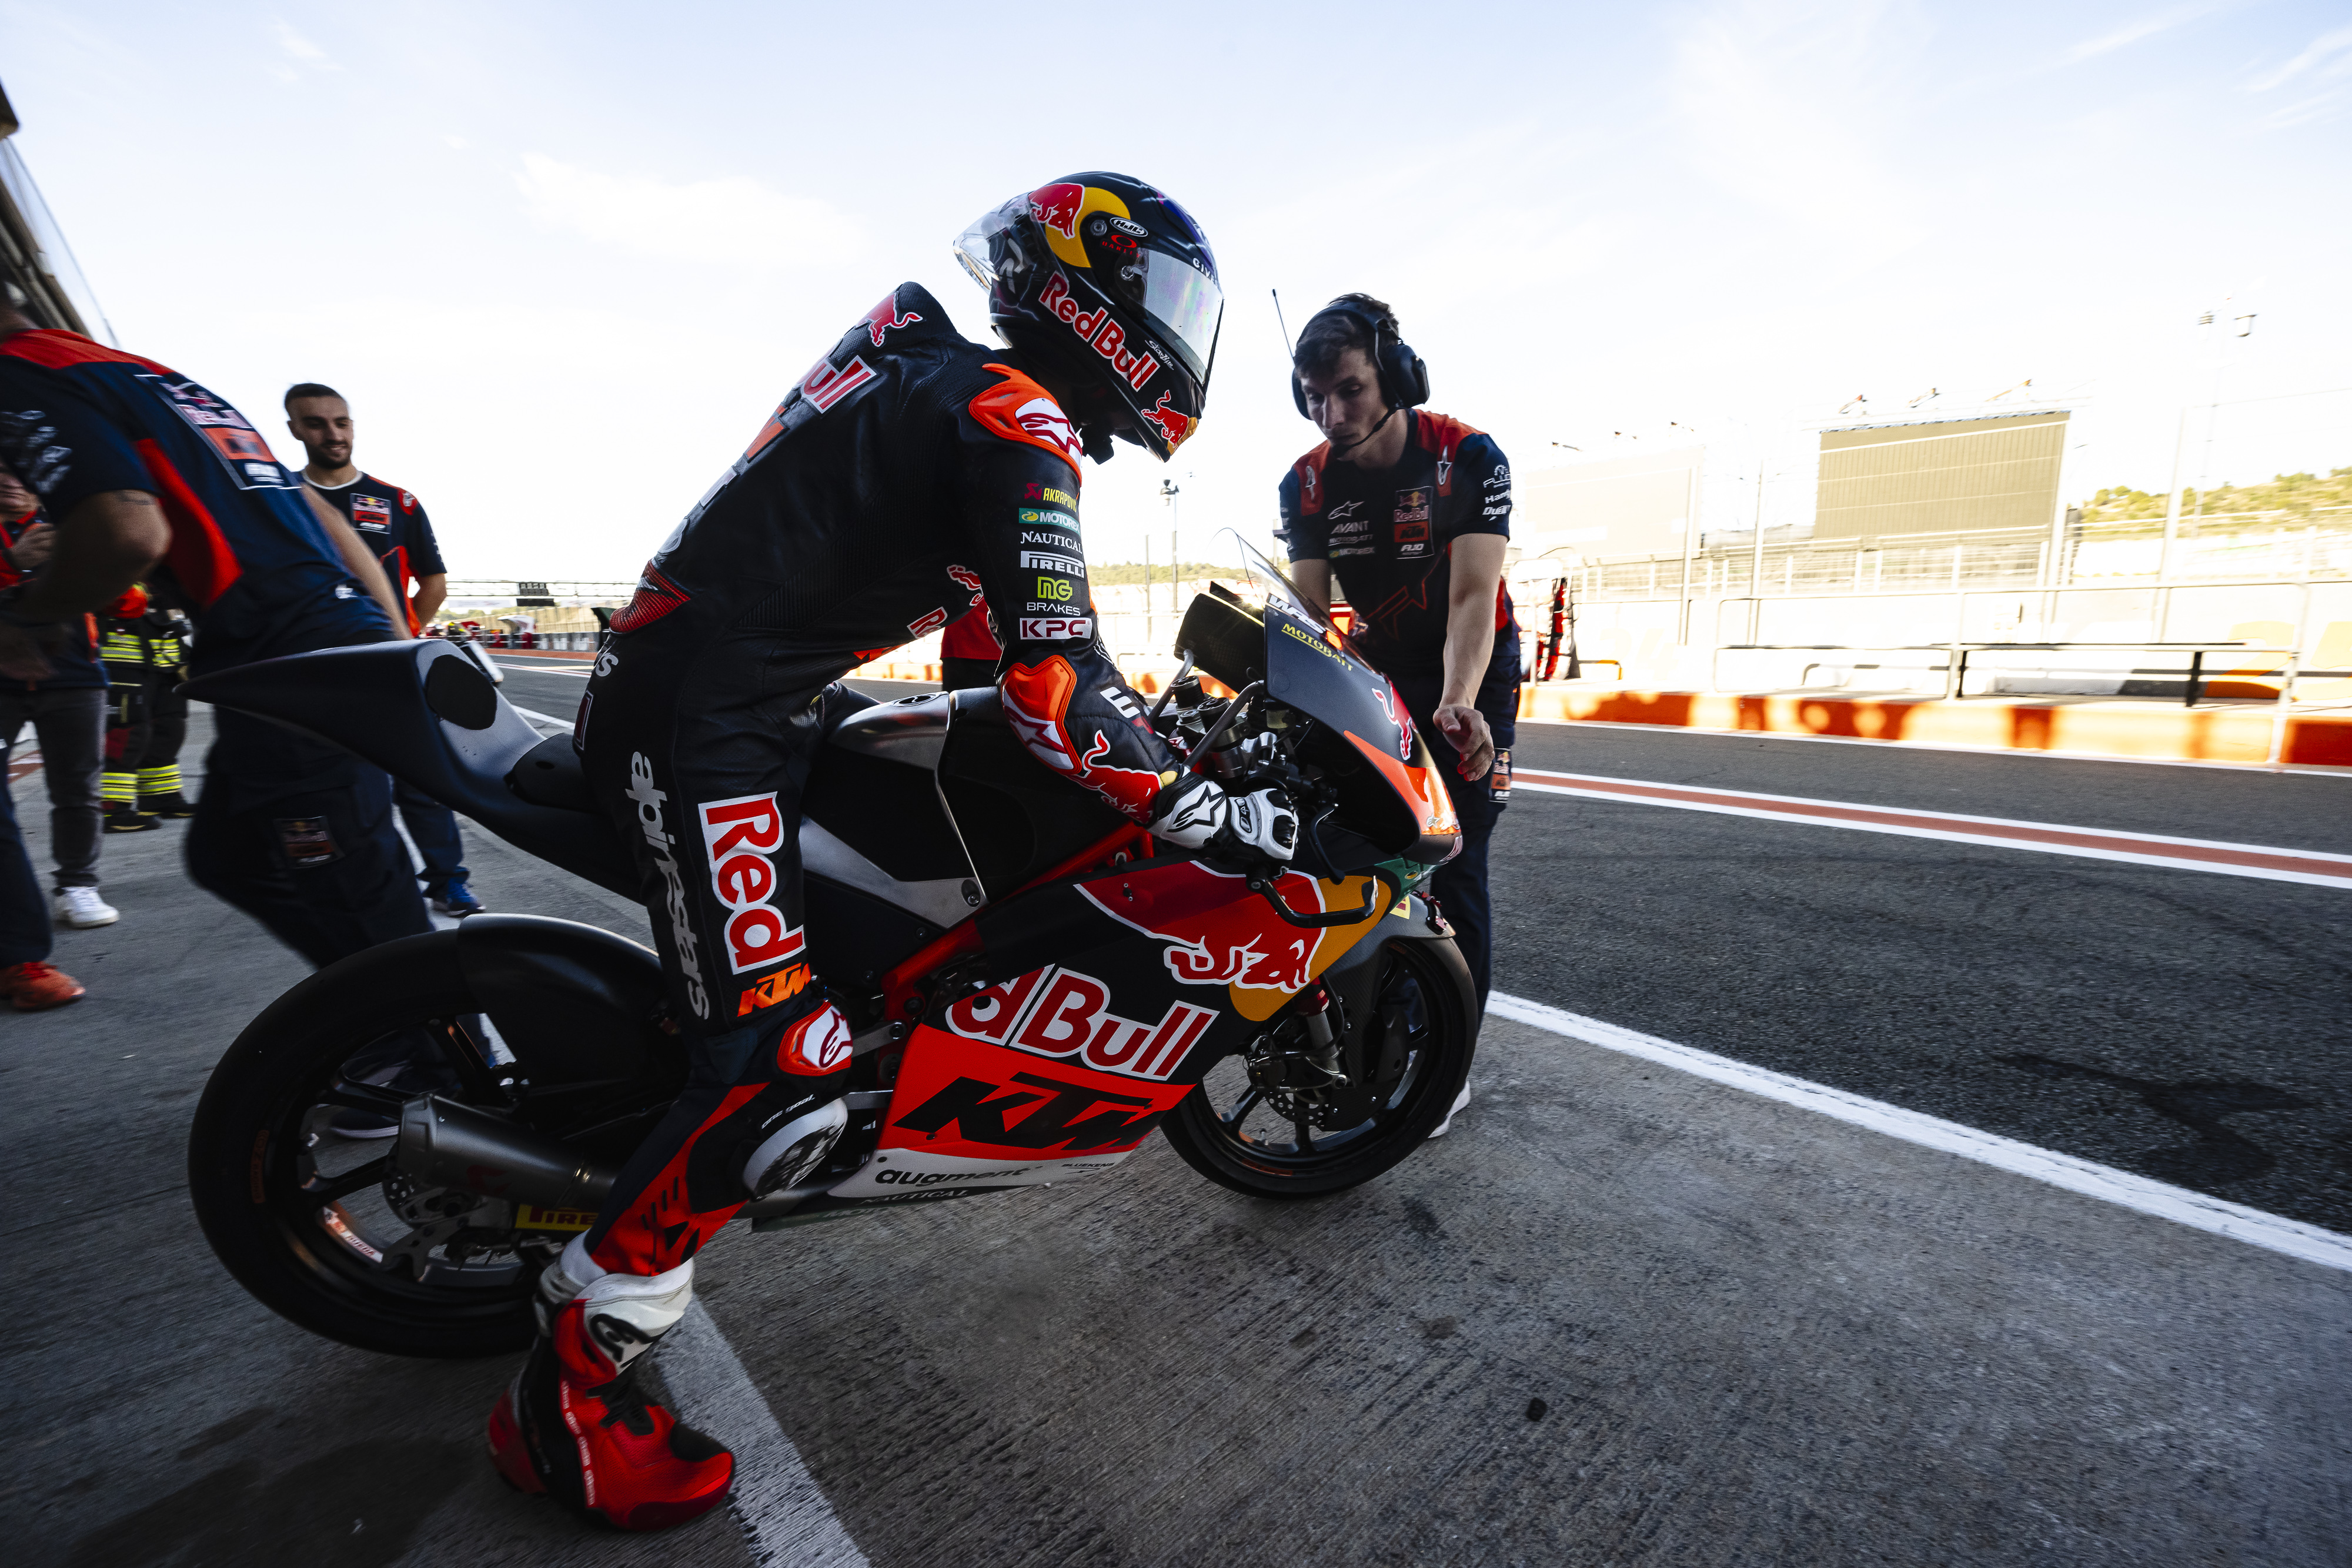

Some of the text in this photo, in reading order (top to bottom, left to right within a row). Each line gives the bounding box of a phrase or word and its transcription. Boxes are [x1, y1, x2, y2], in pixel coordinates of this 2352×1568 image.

[1115, 220, 1144, 234] HJC
[1038, 270, 1161, 392] Red Bull
[1040, 511, 1081, 533] MOTOREX
[1394, 505, 1429, 522] Red Bull
[1331, 520, 1369, 534] AVANT
[1400, 526, 1425, 539] KTM
[1020, 531, 1083, 554] NAUTICAL
[1020, 550, 1084, 579] PIRELLI
[1027, 602, 1081, 617] BRAKES
[1022, 620, 1086, 638] KPC
[1281, 623, 1354, 671] MOTOBATT
[624, 750, 710, 1021] alpinestars
[698, 791, 807, 975] Red
[737, 962, 812, 1017] KTM
[1009, 967, 1220, 1081] Bull
[761, 1110, 784, 1129] one
[891, 1071, 1155, 1151] KTM
[875, 1167, 1032, 1187] augment
[854, 1189, 971, 1206] NAUTICAL
